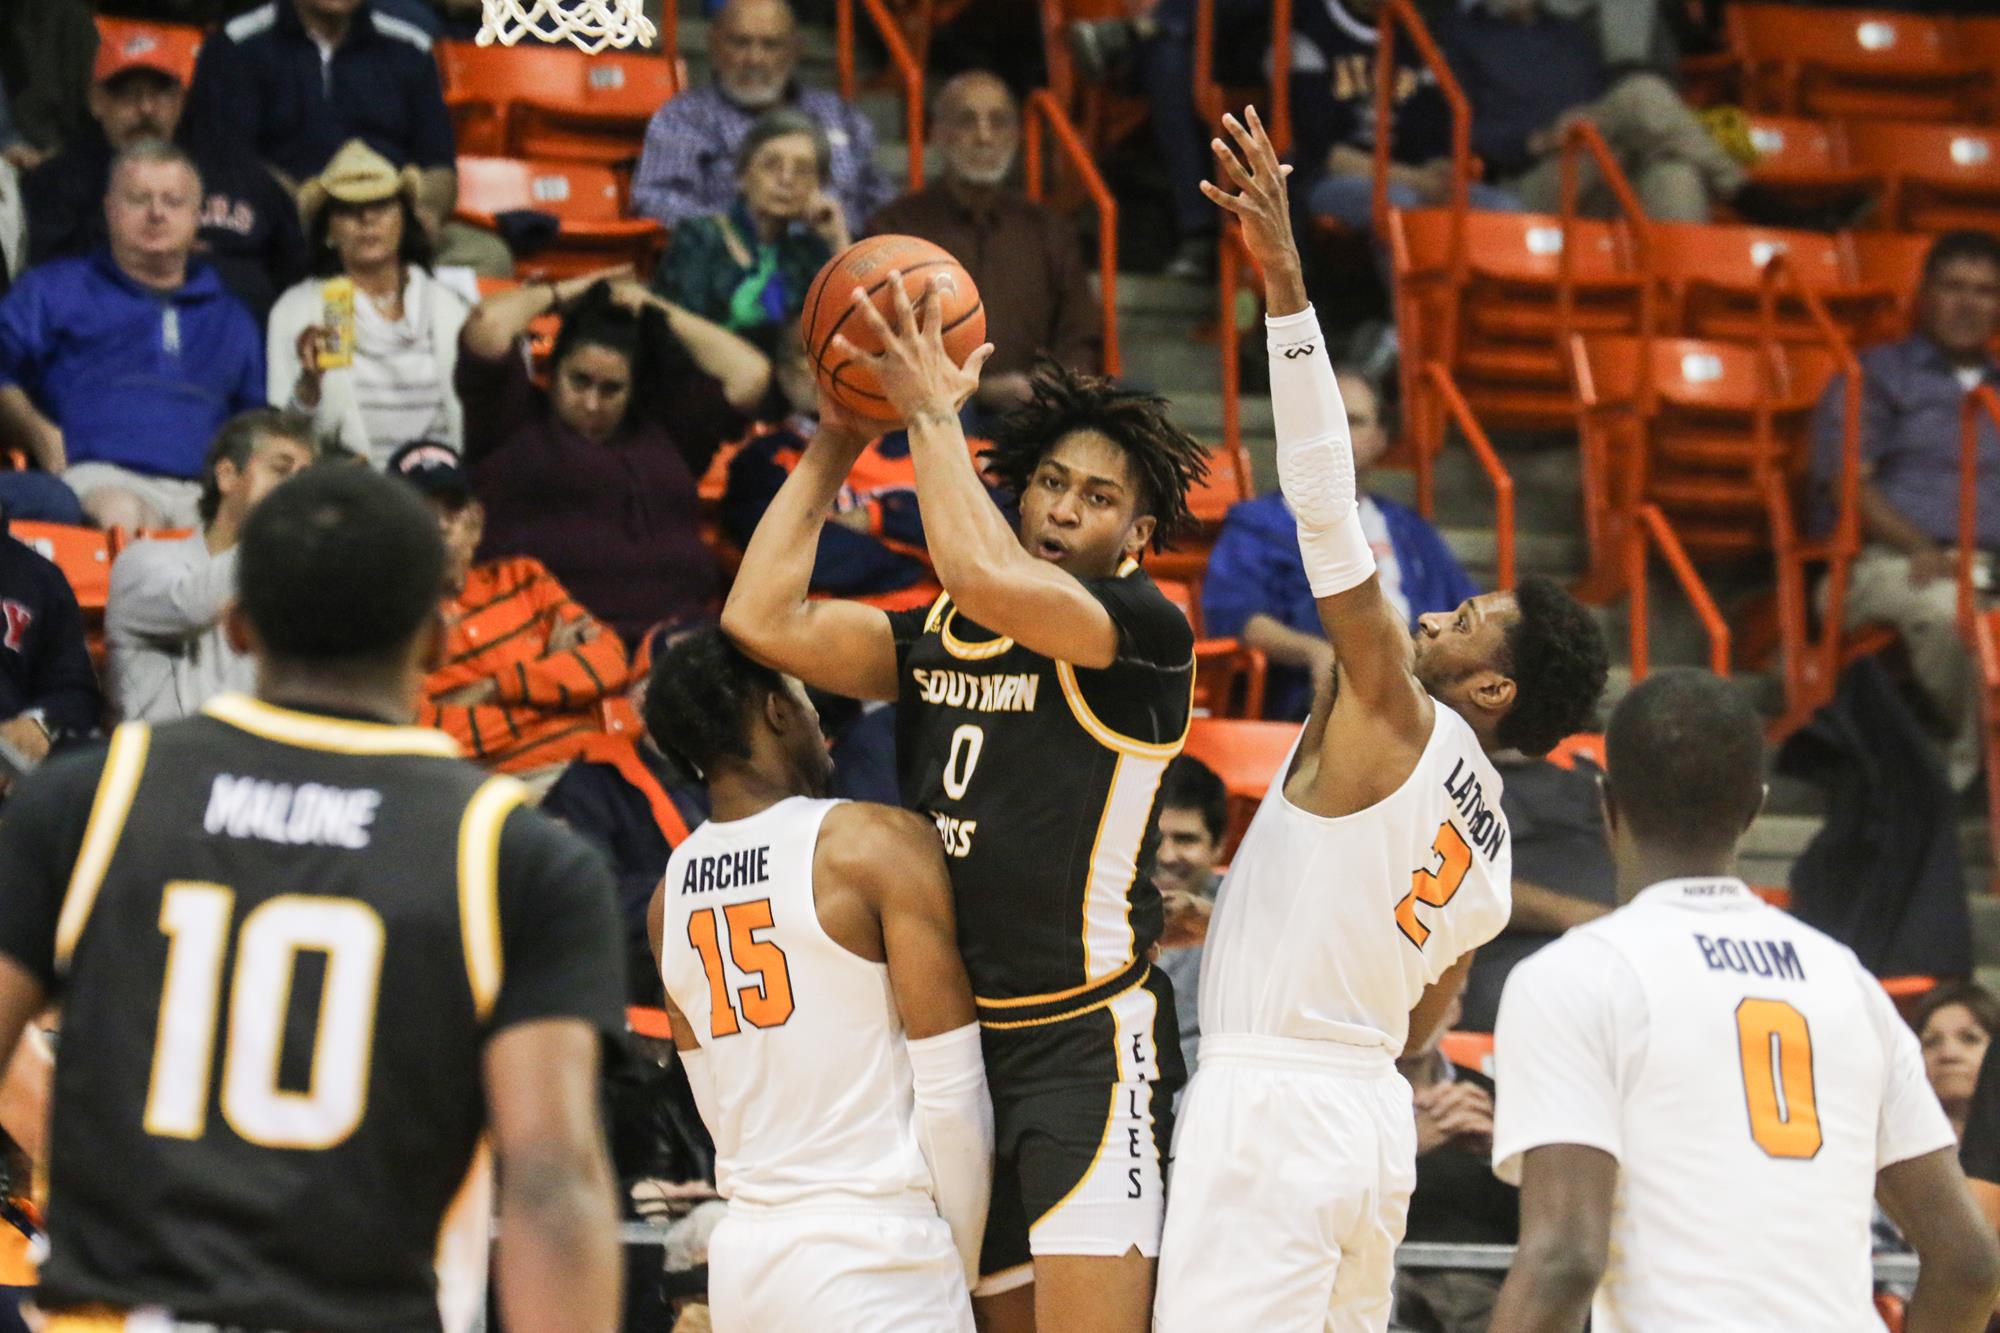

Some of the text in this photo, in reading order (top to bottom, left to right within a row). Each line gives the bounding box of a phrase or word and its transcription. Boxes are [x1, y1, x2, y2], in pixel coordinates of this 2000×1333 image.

[203, 772, 383, 849] MALONE
[943, 723, 984, 800] 0
[681, 845, 771, 895] ARCHIE
[930, 810, 977, 858] ISS
[1394, 818, 1473, 953] 2
[687, 897, 795, 1040] 15
[1692, 933, 1807, 981] BOUM
[143, 880, 386, 1150] 10
[1127, 1032, 1146, 1200] ELES
[1735, 997, 1823, 1161] 0
